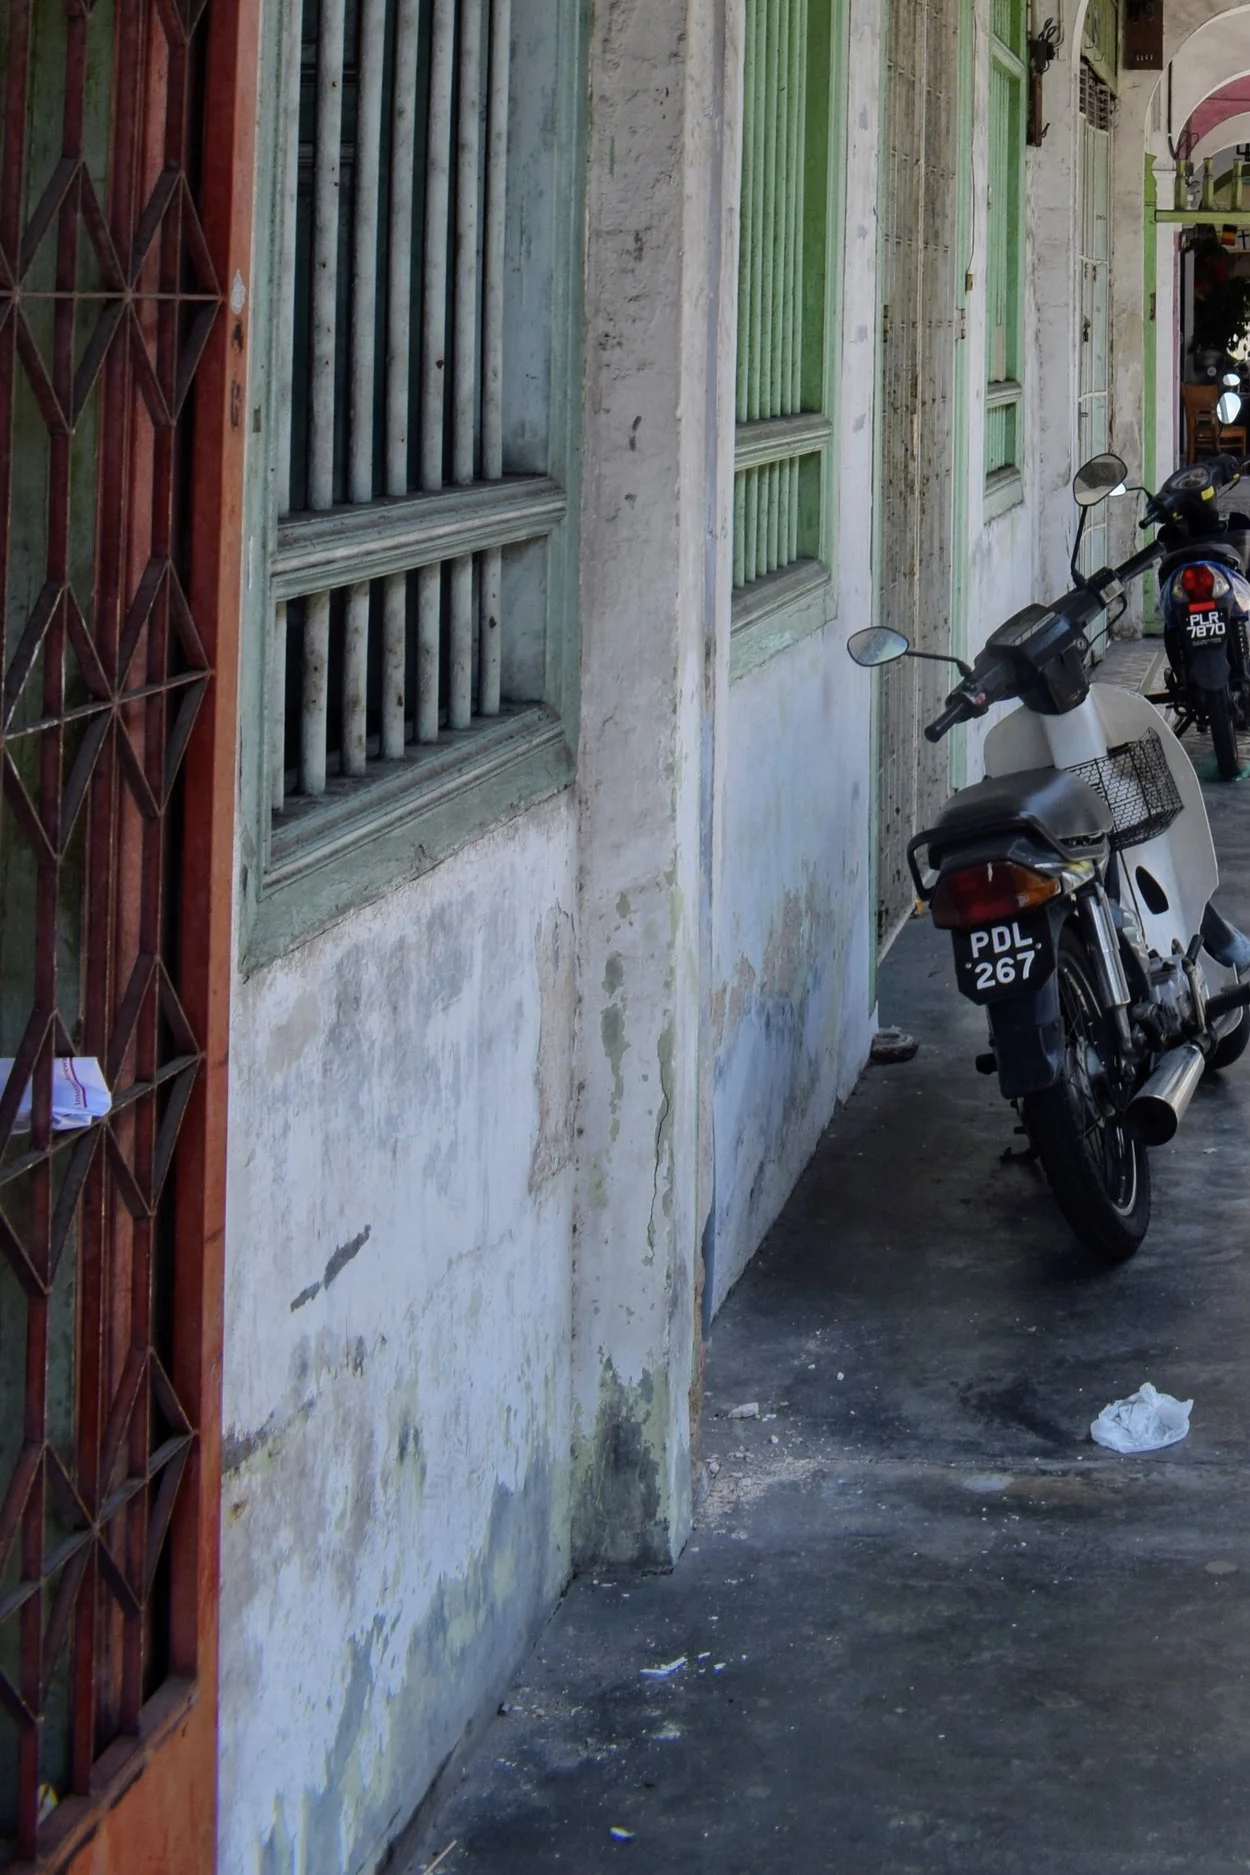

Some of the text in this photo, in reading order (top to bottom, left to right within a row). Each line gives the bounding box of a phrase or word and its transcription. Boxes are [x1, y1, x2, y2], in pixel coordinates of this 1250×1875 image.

[1186, 622, 1226, 638] 7870
[1190, 611, 1219, 626] PLR
[970, 922, 1033, 958] PDL
[974, 950, 1035, 990] 267
